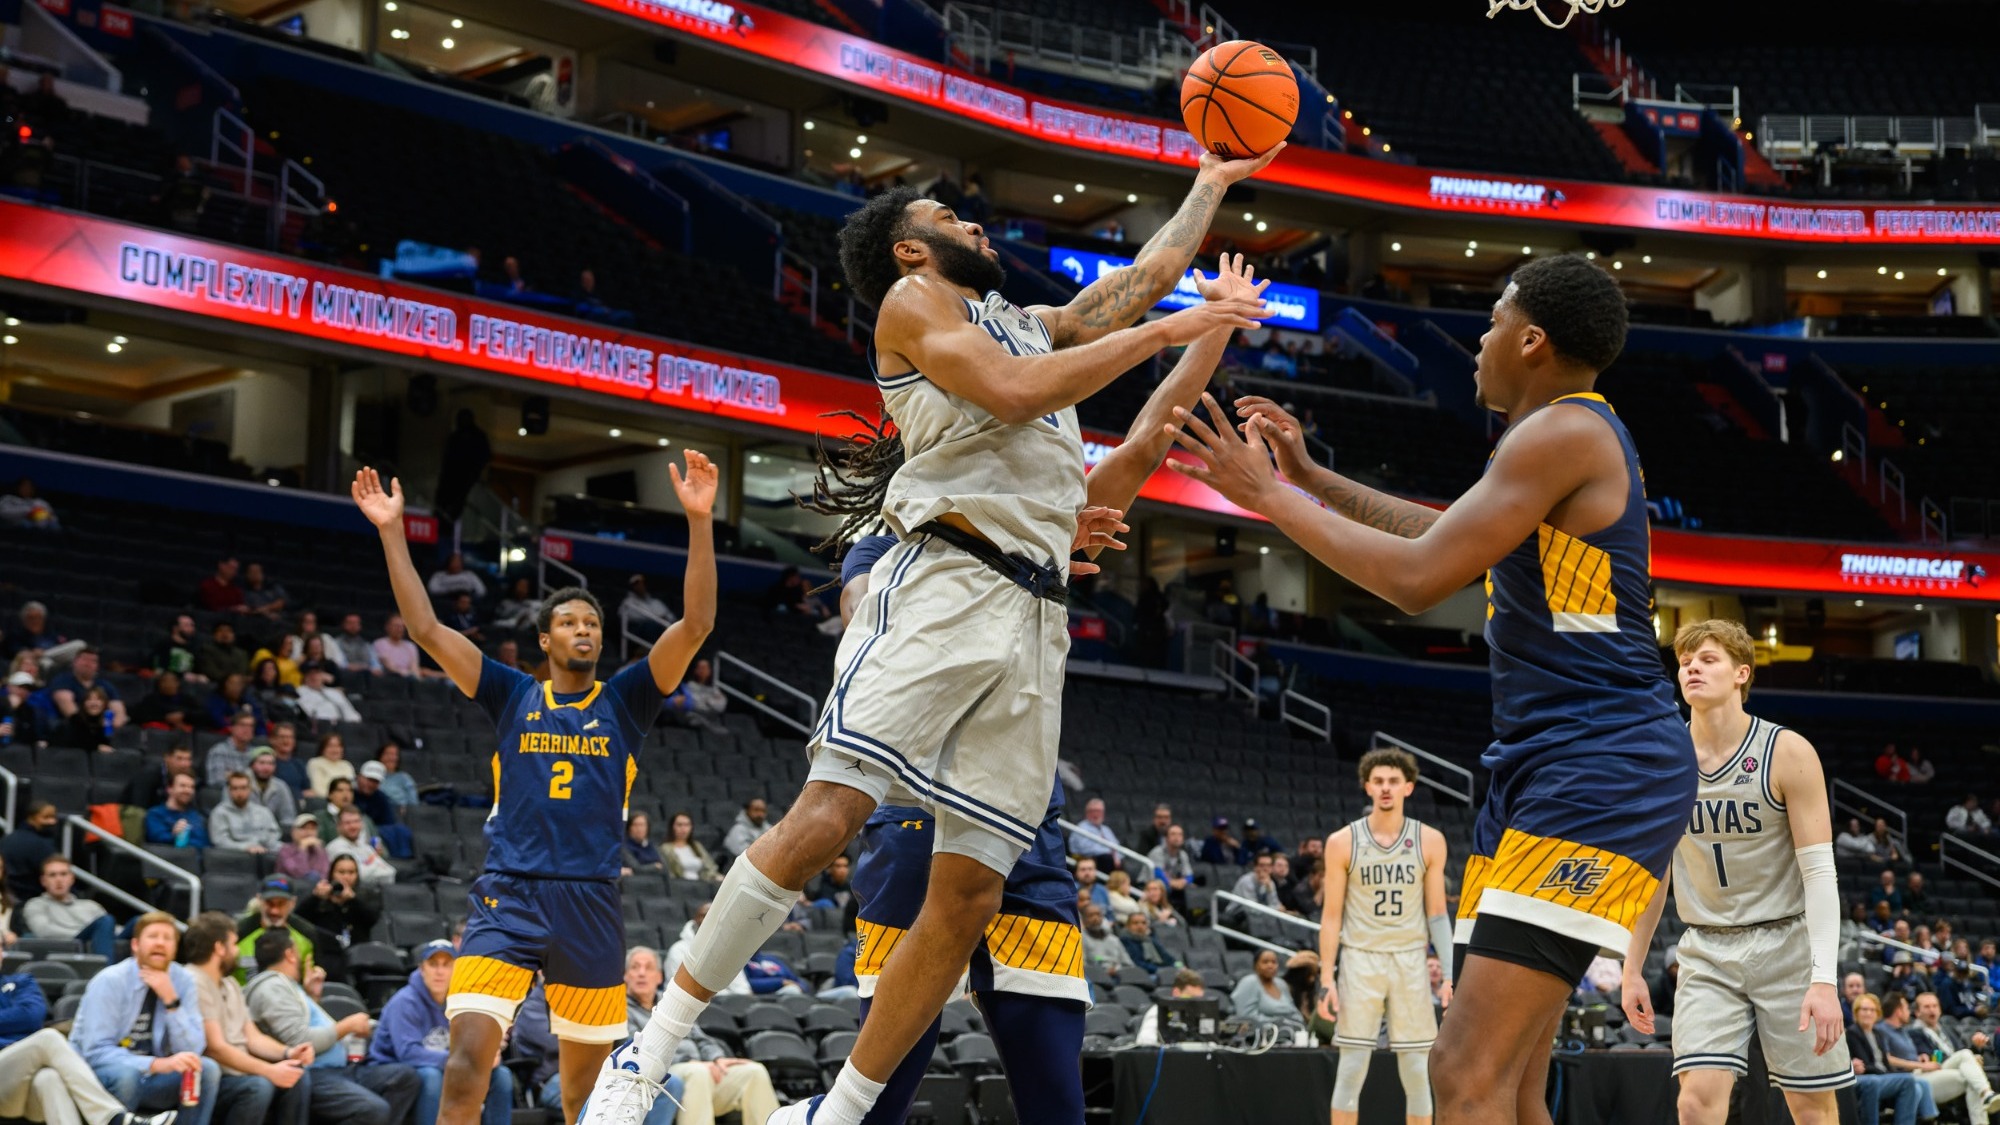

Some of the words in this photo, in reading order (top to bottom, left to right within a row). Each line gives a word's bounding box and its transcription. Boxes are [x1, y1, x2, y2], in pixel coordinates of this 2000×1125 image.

[1031, 101, 1160, 154] PERFORMANCE
[1430, 176, 1546, 202] THUNDERCAT
[1655, 197, 1765, 231] COMPLEXITY
[1768, 206, 1871, 236] MINIMIZED.
[1874, 210, 2000, 237] PERFORMANC
[118, 241, 308, 319] COMPLEXITY
[311, 281, 463, 352] MINIMIZED.
[469, 313, 653, 389] PERFORMANCE
[656, 353, 786, 414] OPTIMIZED.
[1841, 554, 1964, 578] THUNDERCAT
[519, 733, 611, 757] MERRIMACK
[549, 761, 574, 799] 2
[1689, 799, 1762, 835] OYAS
[1360, 864, 1415, 886] HOYAS
[1538, 857, 1611, 897] MC
[1712, 843, 1728, 887] 1
[1374, 890, 1403, 916] 25
